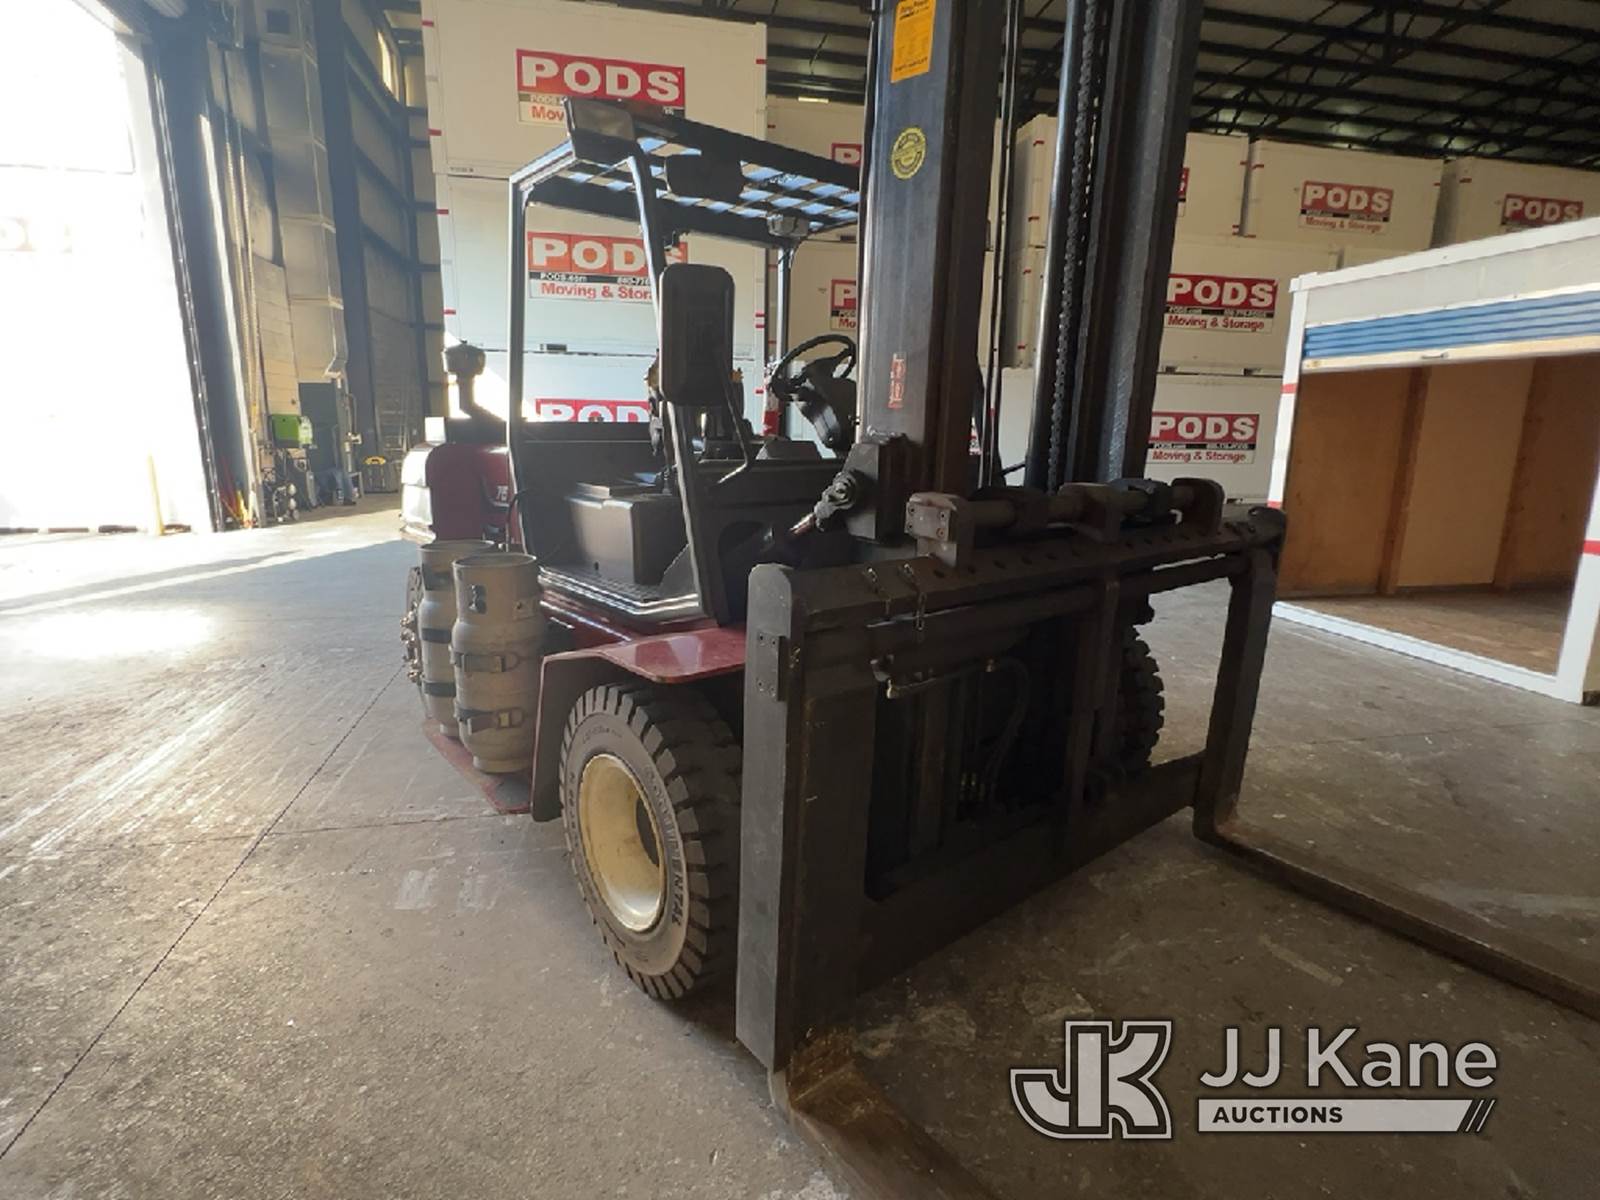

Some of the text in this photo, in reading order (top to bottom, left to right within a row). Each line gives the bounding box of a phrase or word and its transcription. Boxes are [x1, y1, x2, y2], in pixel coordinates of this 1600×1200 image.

[520, 55, 681, 102] PODS
[531, 105, 565, 121] Mov
[1303, 184, 1390, 213] PODS
[1505, 198, 1580, 222] PODS
[541, 282, 652, 299] Moving & Stor
[1166, 277, 1274, 308] PODS
[1167, 314, 1207, 329] Moving
[1222, 316, 1265, 332] Storage
[540, 403, 650, 422] POD
[1150, 415, 1255, 441] PODS
[1152, 450, 1191, 464] Moving
[1205, 451, 1247, 464] Storage
